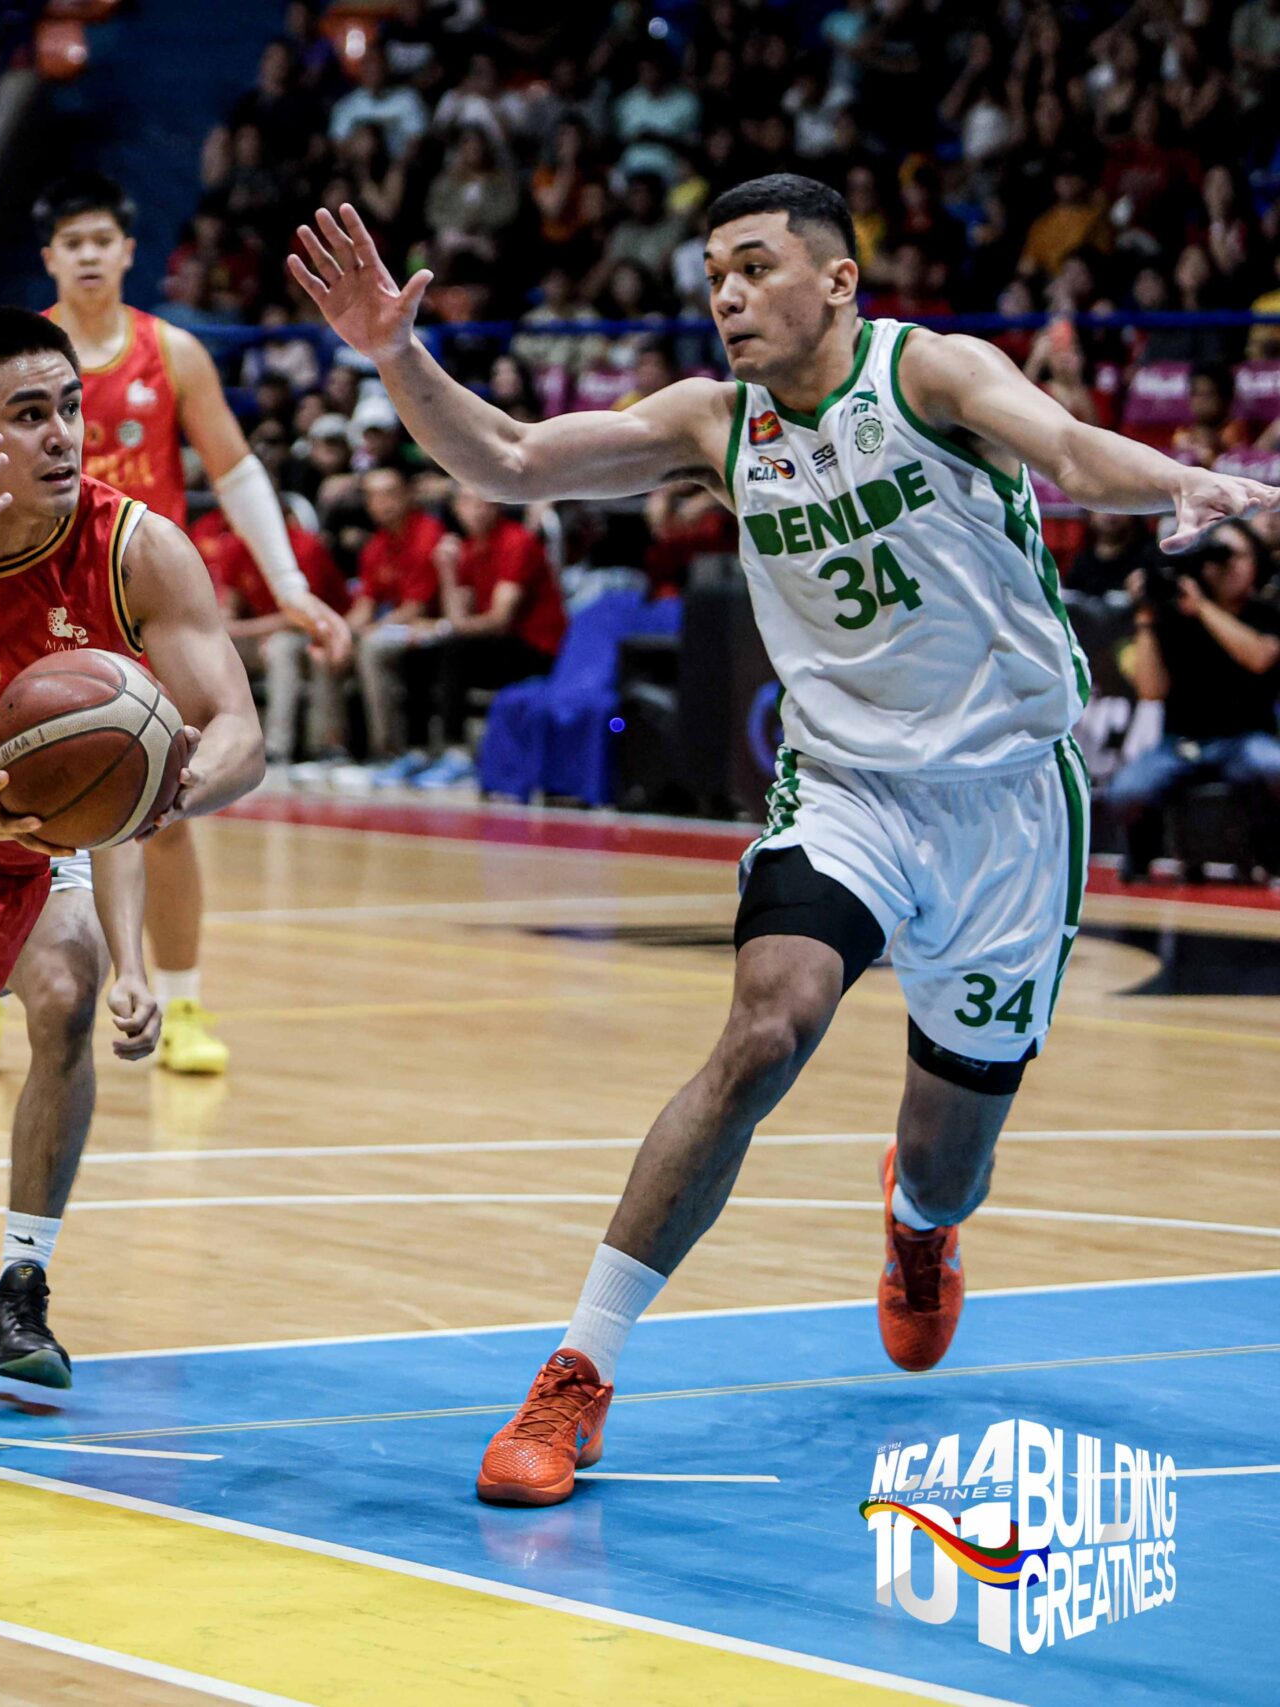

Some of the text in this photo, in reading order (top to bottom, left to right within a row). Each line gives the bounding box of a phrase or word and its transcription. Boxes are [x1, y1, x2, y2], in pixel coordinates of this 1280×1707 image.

[747, 465, 778, 482] NCAA
[818, 541, 923, 630] 34
[0, 735, 31, 762] NCAA
[954, 972, 1036, 1034] 34
